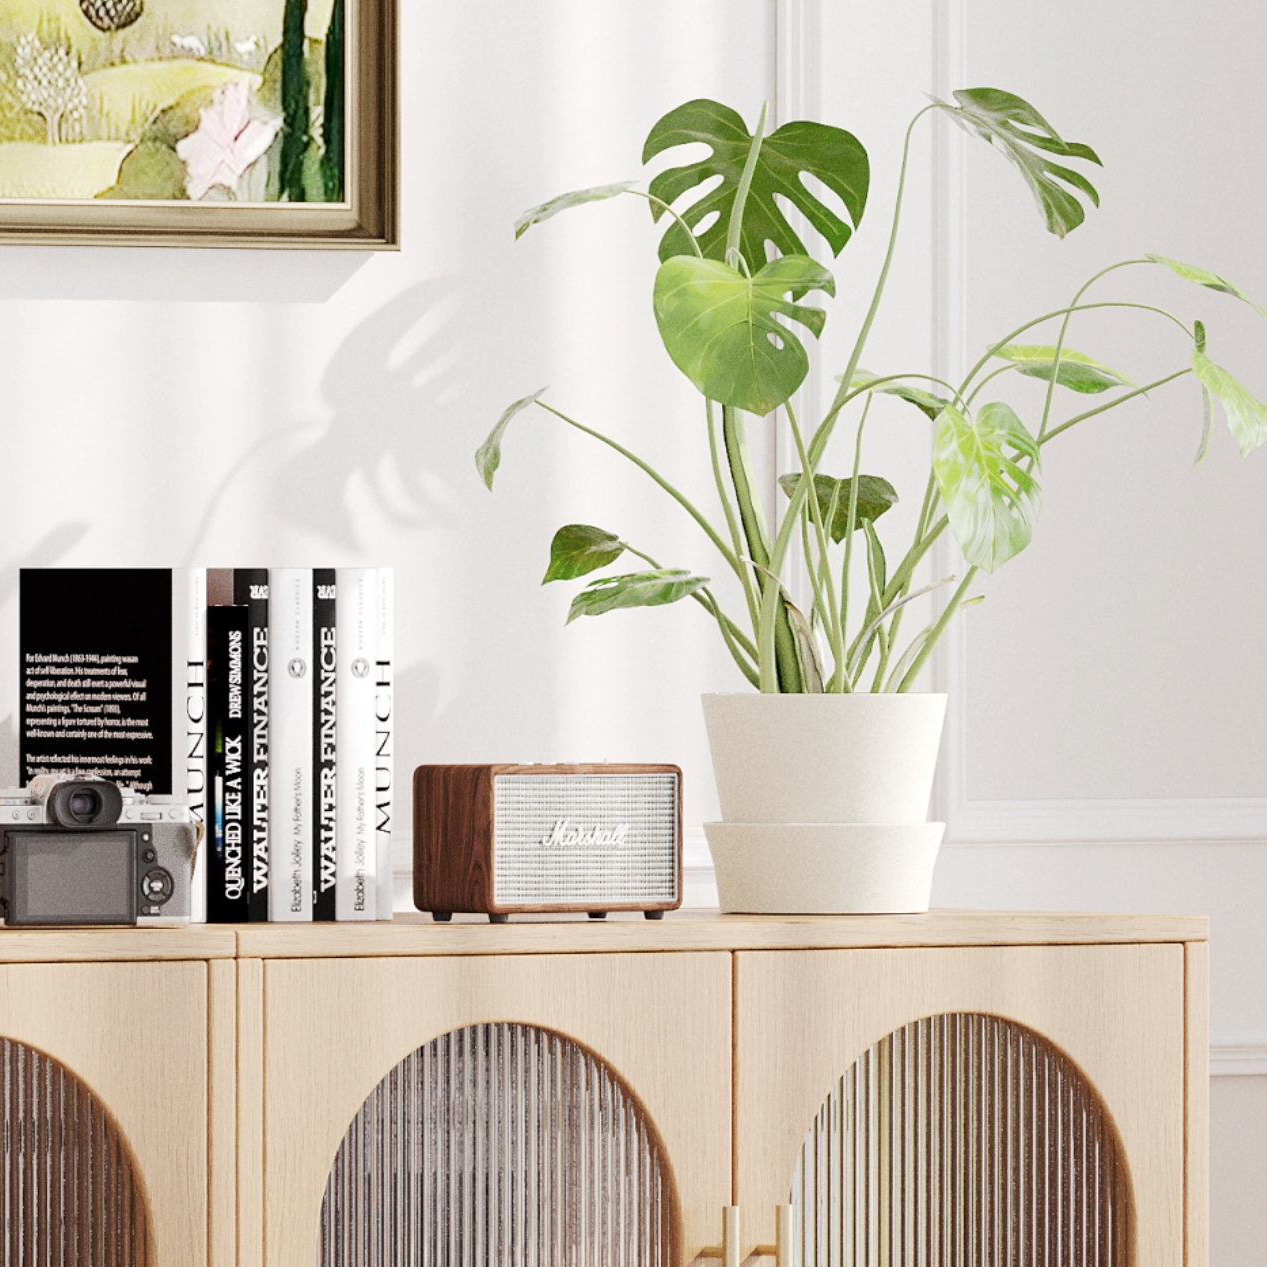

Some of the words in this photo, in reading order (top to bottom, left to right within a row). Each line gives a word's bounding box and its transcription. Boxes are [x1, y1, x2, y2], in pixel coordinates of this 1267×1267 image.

[228, 631, 242, 685] SIMMONS
[228, 685, 242, 720] DREW
[253, 627, 268, 763] FINANCE
[320, 627, 335, 763] FINANCE
[225, 735, 242, 777] WICK
[376, 661, 391, 836] MUNCH
[225, 779, 242, 791] A
[225, 793, 242, 821] LIKE
[253, 765, 268, 894] WALTER
[320, 765, 335, 893] WALTER
[541, 817, 629, 847] Marshall
[225, 823, 245, 900] QUENCHED
[291, 870, 302, 913] Elizabeth
